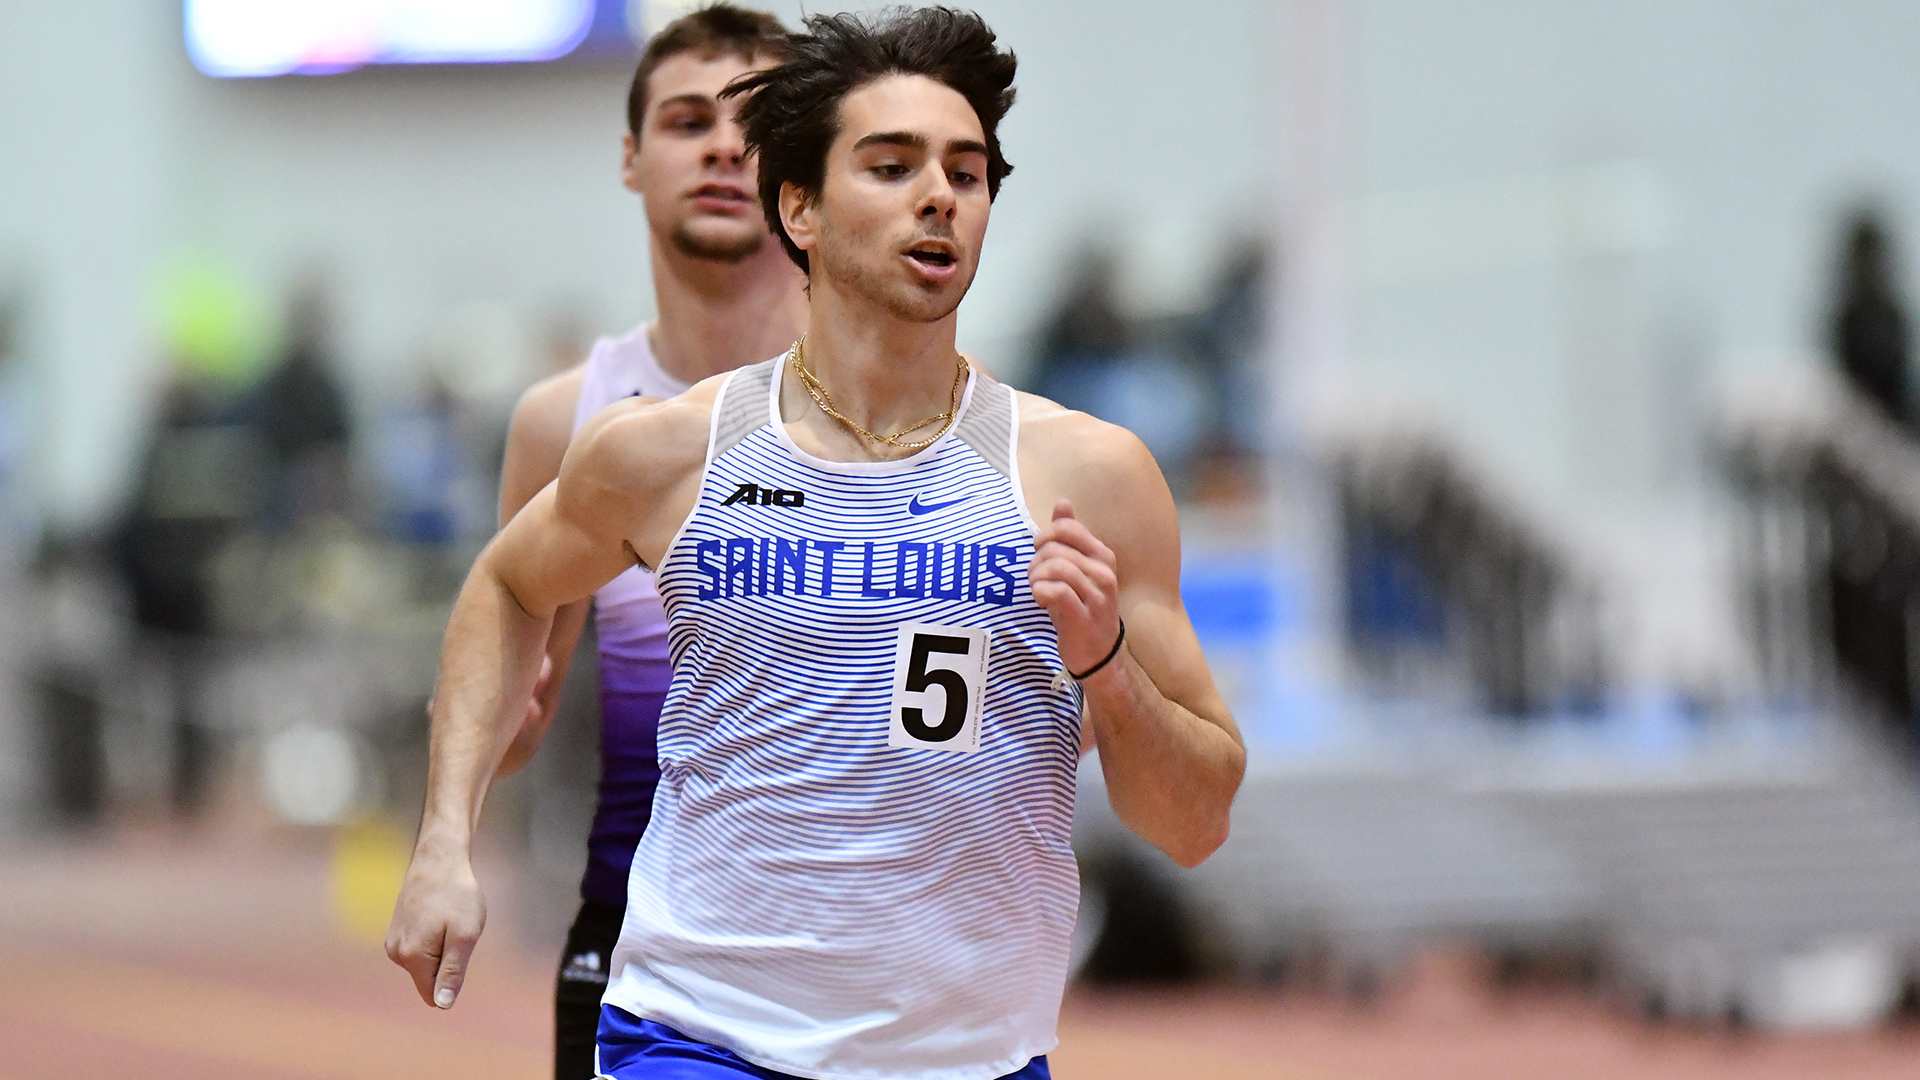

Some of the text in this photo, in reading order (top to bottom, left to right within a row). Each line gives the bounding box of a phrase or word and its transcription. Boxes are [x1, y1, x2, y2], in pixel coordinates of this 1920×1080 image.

[720, 483, 805, 507] A10
[697, 537, 1017, 606] SAINT LOUIS
[901, 633, 970, 742] 5
